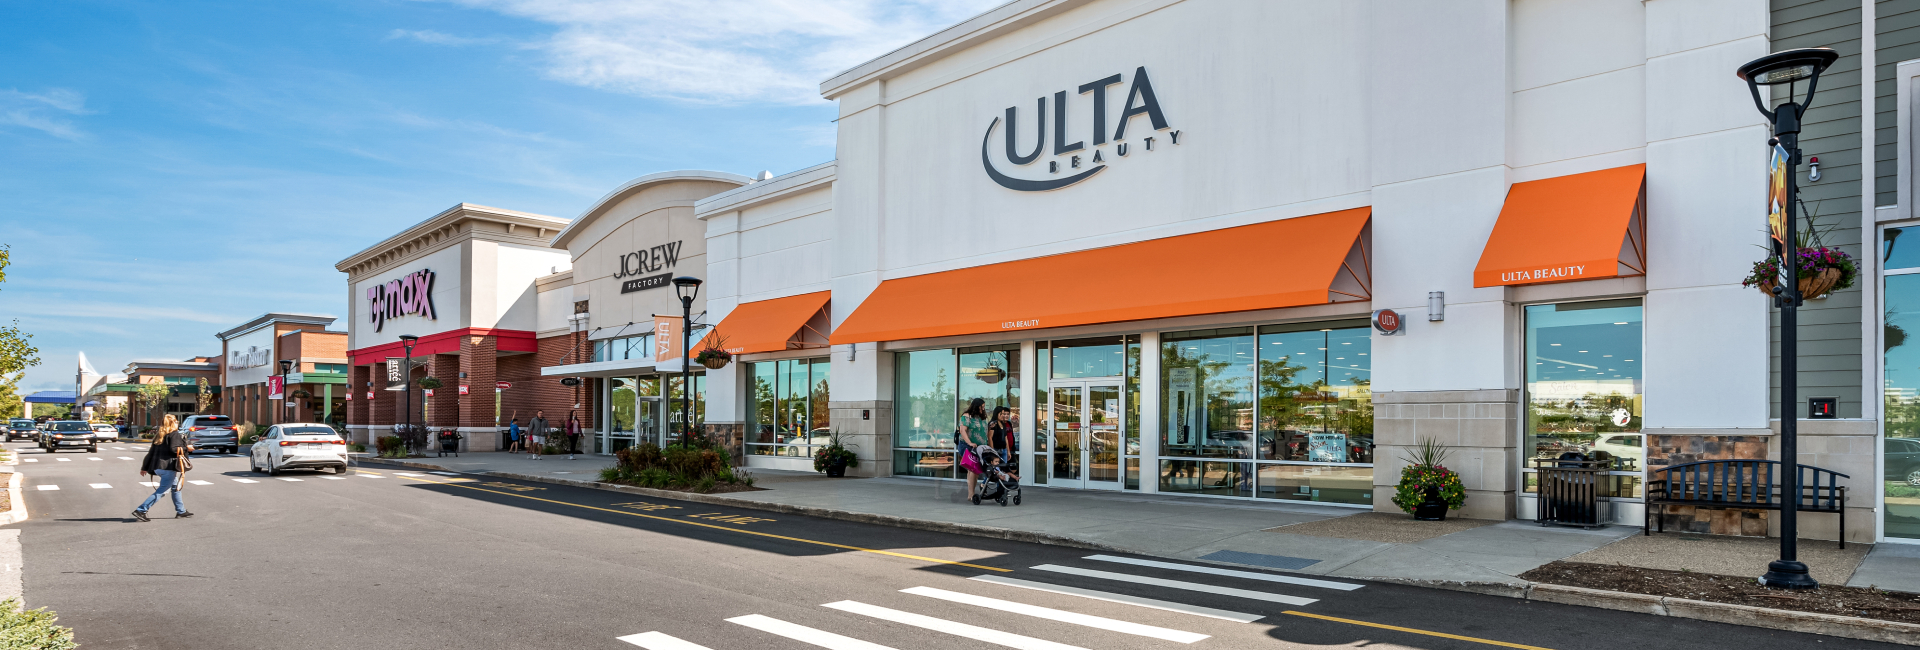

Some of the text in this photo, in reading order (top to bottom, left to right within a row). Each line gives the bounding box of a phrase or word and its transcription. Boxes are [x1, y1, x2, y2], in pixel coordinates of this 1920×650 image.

[1005, 65, 1169, 165] ULTA
[1049, 129, 1182, 174] BEAUTY
[613, 240, 682, 279] J.CREW
[1501, 265, 1585, 282] ULTA BEAUTY
[628, 277, 663, 290] FACTORY
[1001, 319, 1040, 329] ULTA BEAUTY
[1381, 314, 1396, 327] ULTA
[658, 322, 670, 355] ULTA
[1083, 361, 1092, 374] 16
[669, 406, 694, 423] arté
